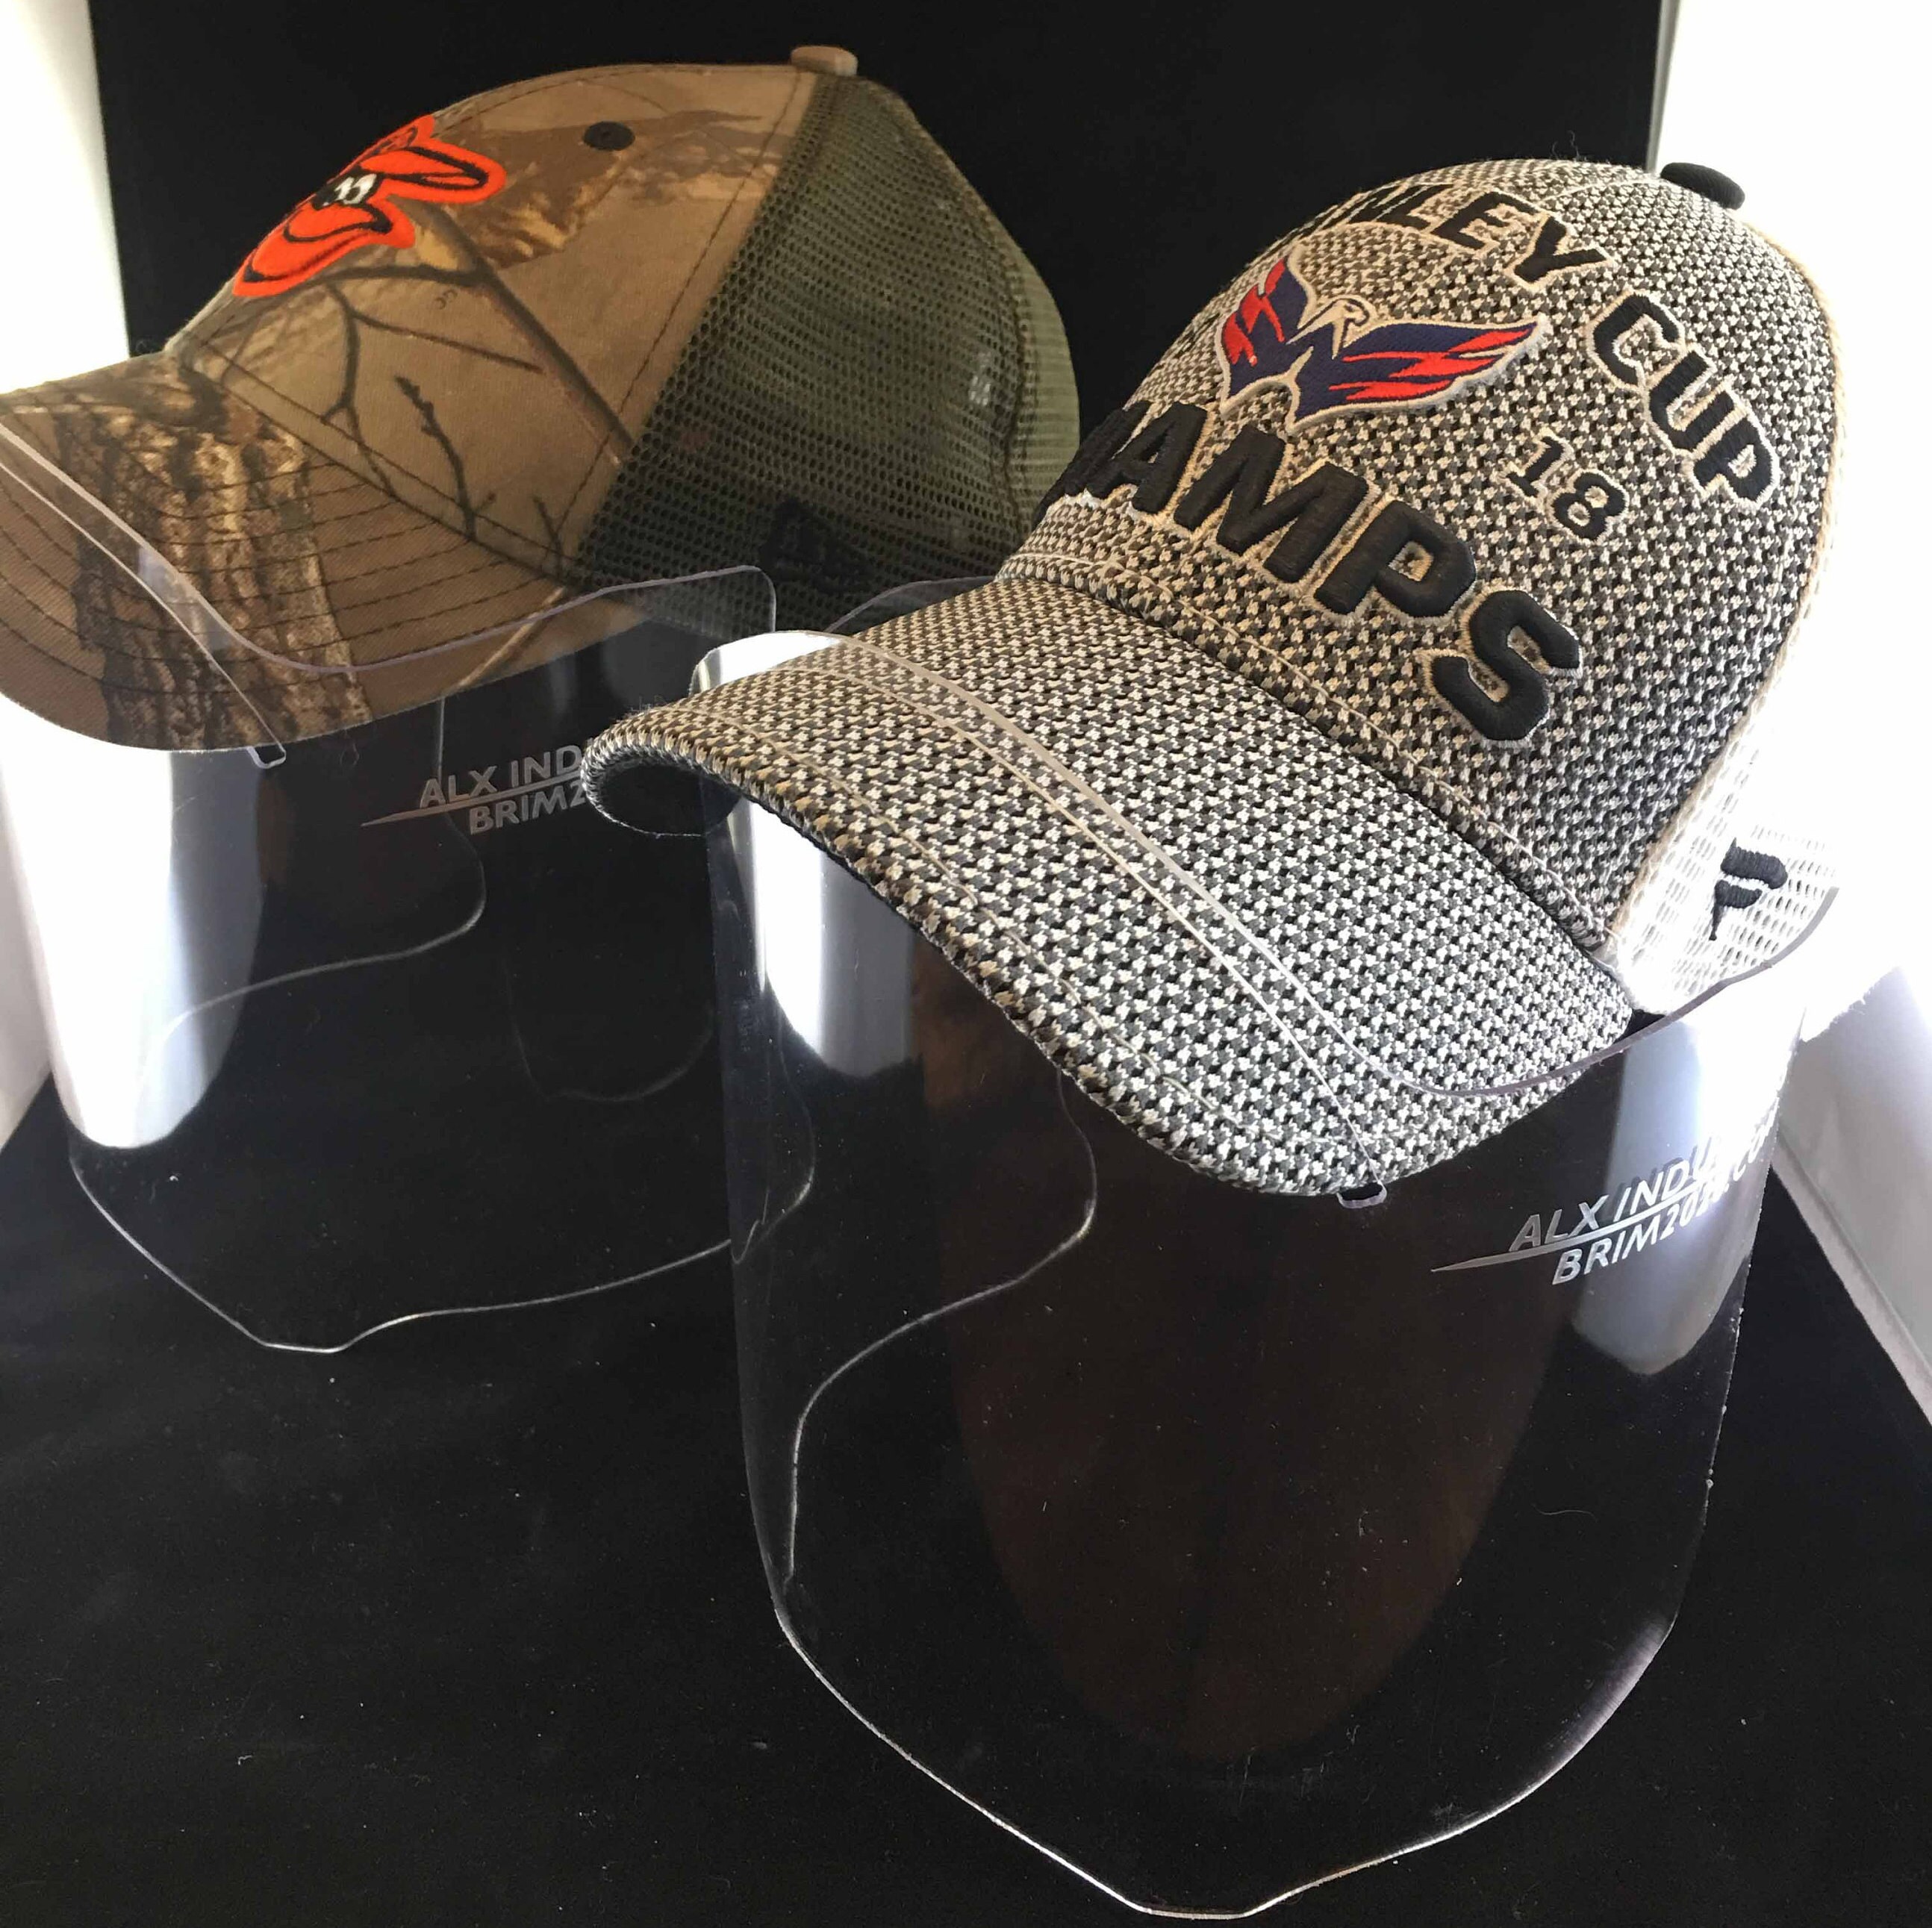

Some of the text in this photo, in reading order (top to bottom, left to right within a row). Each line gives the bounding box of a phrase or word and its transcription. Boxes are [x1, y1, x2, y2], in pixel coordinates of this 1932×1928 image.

[1592, 293, 1780, 503] CUP
[1506, 431, 1627, 542] 18
[420, 740, 592, 808] ALX IND
[469, 782, 588, 835] BRIM2
[1508, 1194, 1609, 1252] ALX
